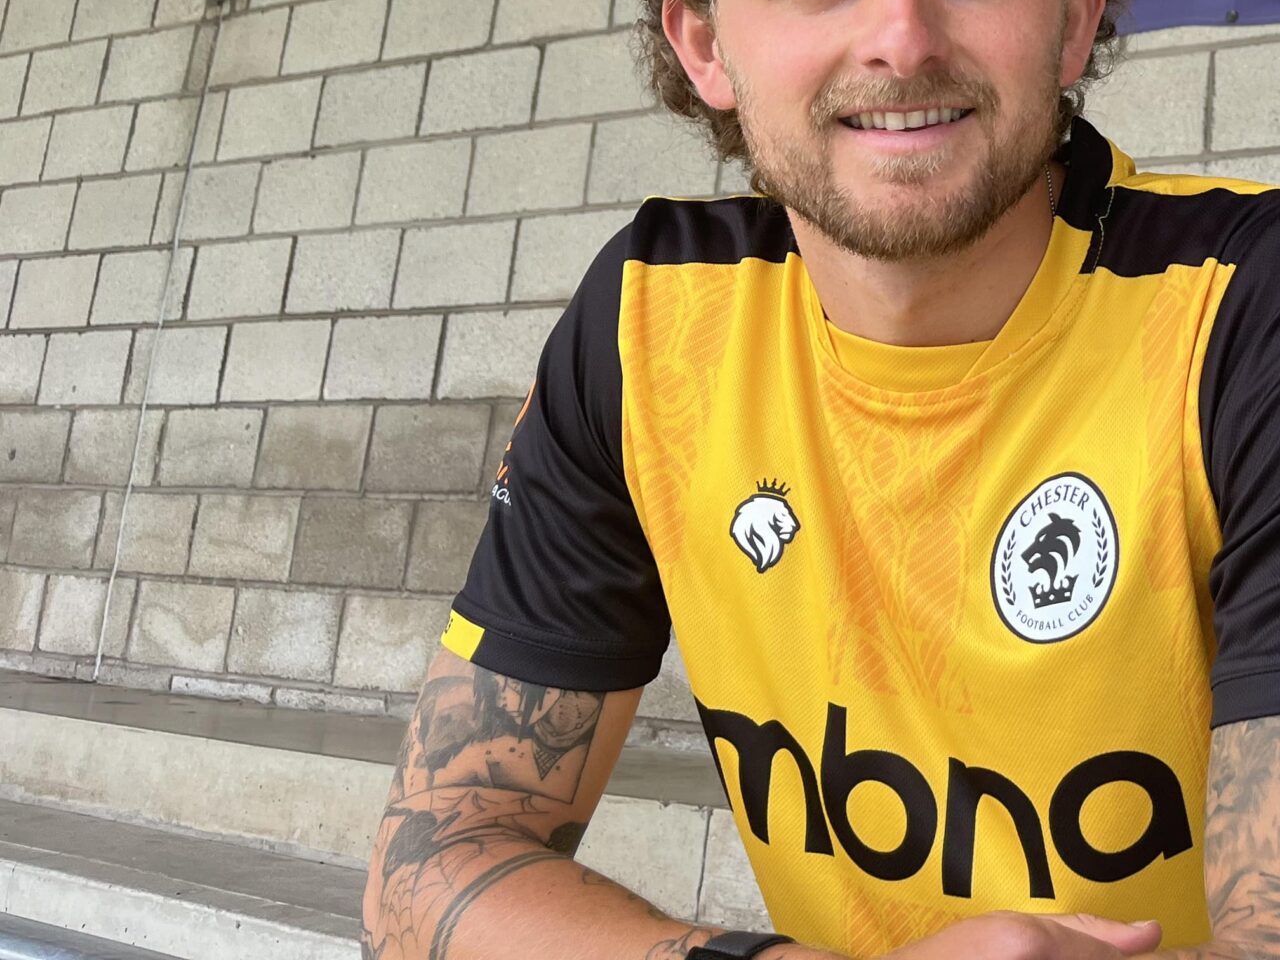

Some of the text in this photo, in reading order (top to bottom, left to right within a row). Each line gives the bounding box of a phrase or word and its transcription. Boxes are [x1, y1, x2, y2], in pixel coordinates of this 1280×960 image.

[1019, 483, 1090, 528] CHESTER
[1015, 593, 1095, 631] FOOTBALL CLUB
[692, 695, 1194, 900] mbna
